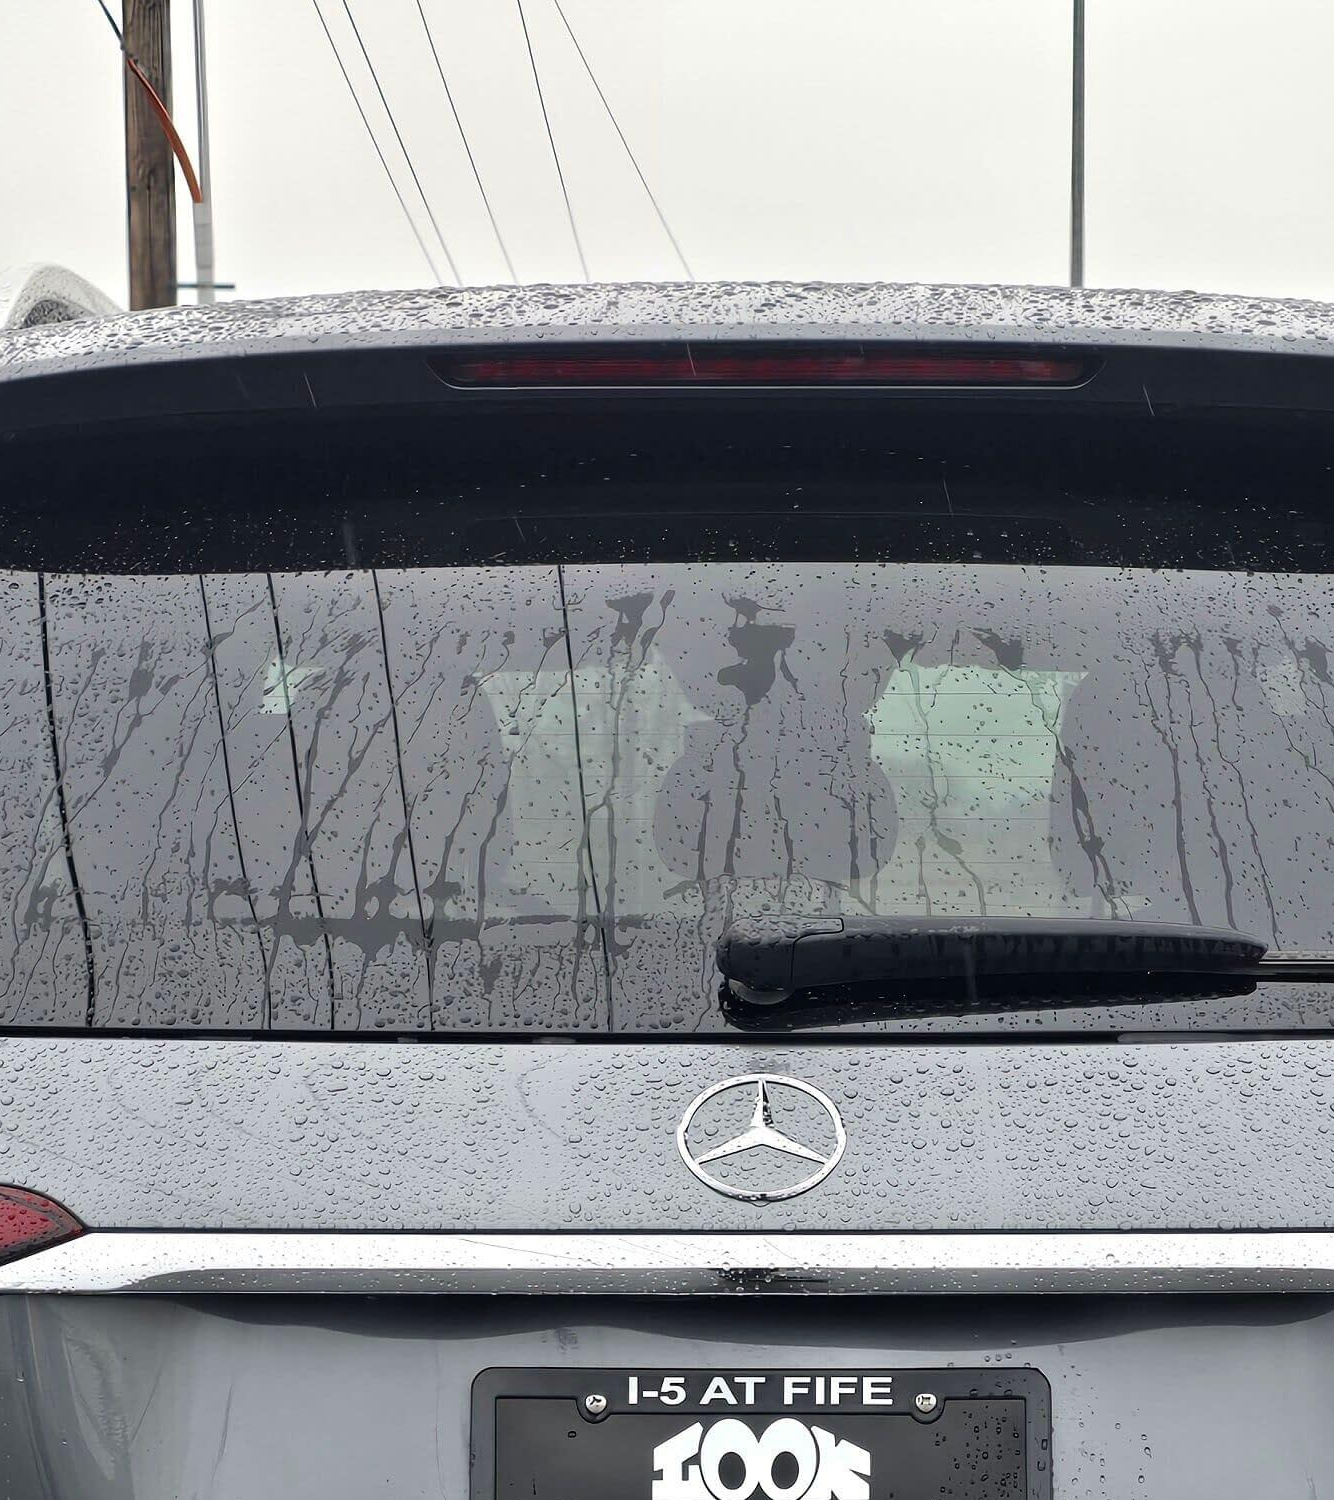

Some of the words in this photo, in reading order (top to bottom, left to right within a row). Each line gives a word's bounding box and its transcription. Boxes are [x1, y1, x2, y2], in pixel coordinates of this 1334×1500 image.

[628, 1376, 687, 1405] I-5
[699, 1376, 766, 1405] AT
[783, 1376, 894, 1405] FIFE
